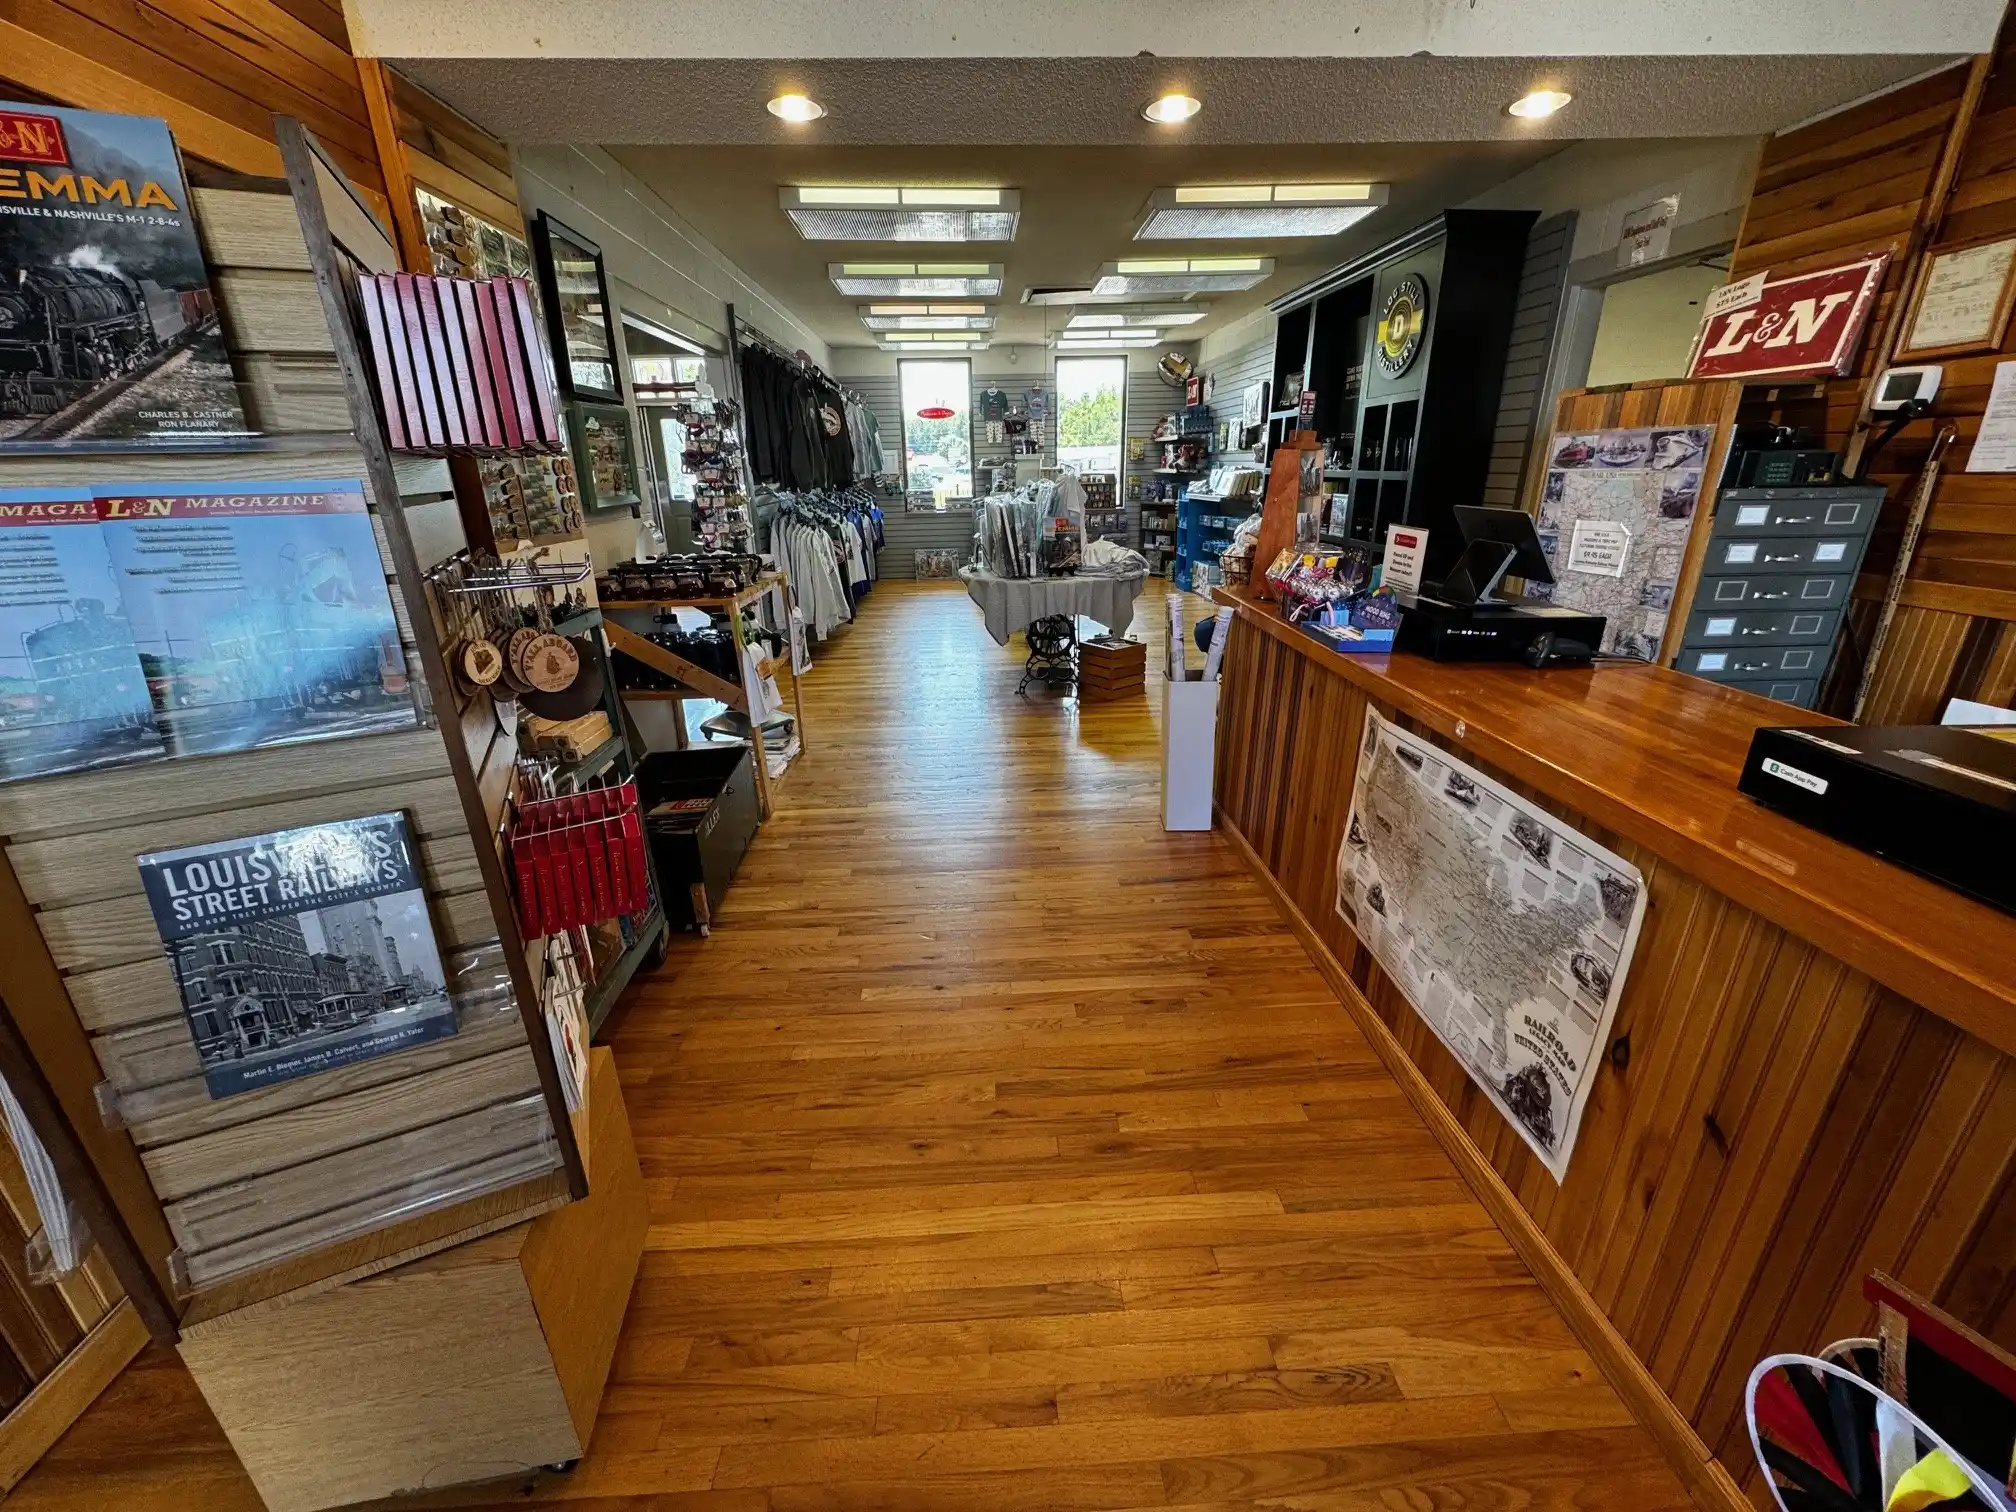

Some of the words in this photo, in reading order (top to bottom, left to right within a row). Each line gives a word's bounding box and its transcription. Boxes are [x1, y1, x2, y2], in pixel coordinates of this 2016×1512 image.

[42, 208, 53, 217] &
[55, 208, 125, 223] NASHVILLE'S
[126, 214, 145, 224] M-1
[147, 216, 181, 227] 2-8-4s
[1383, 287, 1399, 315] LOG
[1400, 281, 1419, 305] STILL
[1703, 291, 1853, 358] L&N
[1377, 339, 1413, 373] DISTILLERY
[138, 411, 180, 419] CHARLES
[193, 411, 234, 419] CASTNER
[158, 420, 178, 428] RON
[179, 420, 220, 428] FLANARY
[0, 503, 98, 517] MAGA
[105, 498, 177, 518] L&N
[184, 494, 325, 509] MAGAZINE
[1780, 768, 1794, 778] Cash
[1794, 774, 1806, 783] App
[1806, 779, 1818, 788] Pay
[172, 882, 270, 921] STREET
[277, 859, 399, 901] RAILWAYS
[179, 920, 200, 932] AND
[205, 915, 227, 926] HOW
[232, 908, 256, 921] THEY
[262, 901, 300, 914] SHAPED
[304, 896, 322, 906] THE
[327, 887, 360, 902] CITY'S
[1524, 1014, 1577, 1073] RAILROAD
[1528, 1027, 1552, 1049] LEGACY
[1552, 1049, 1566, 1067] MAP
[242, 1067, 267, 1080] Martin
[304, 1053, 326, 1064] James
[1514, 1032, 1543, 1058] UNITED
[1543, 1054, 1572, 1097] STATES
